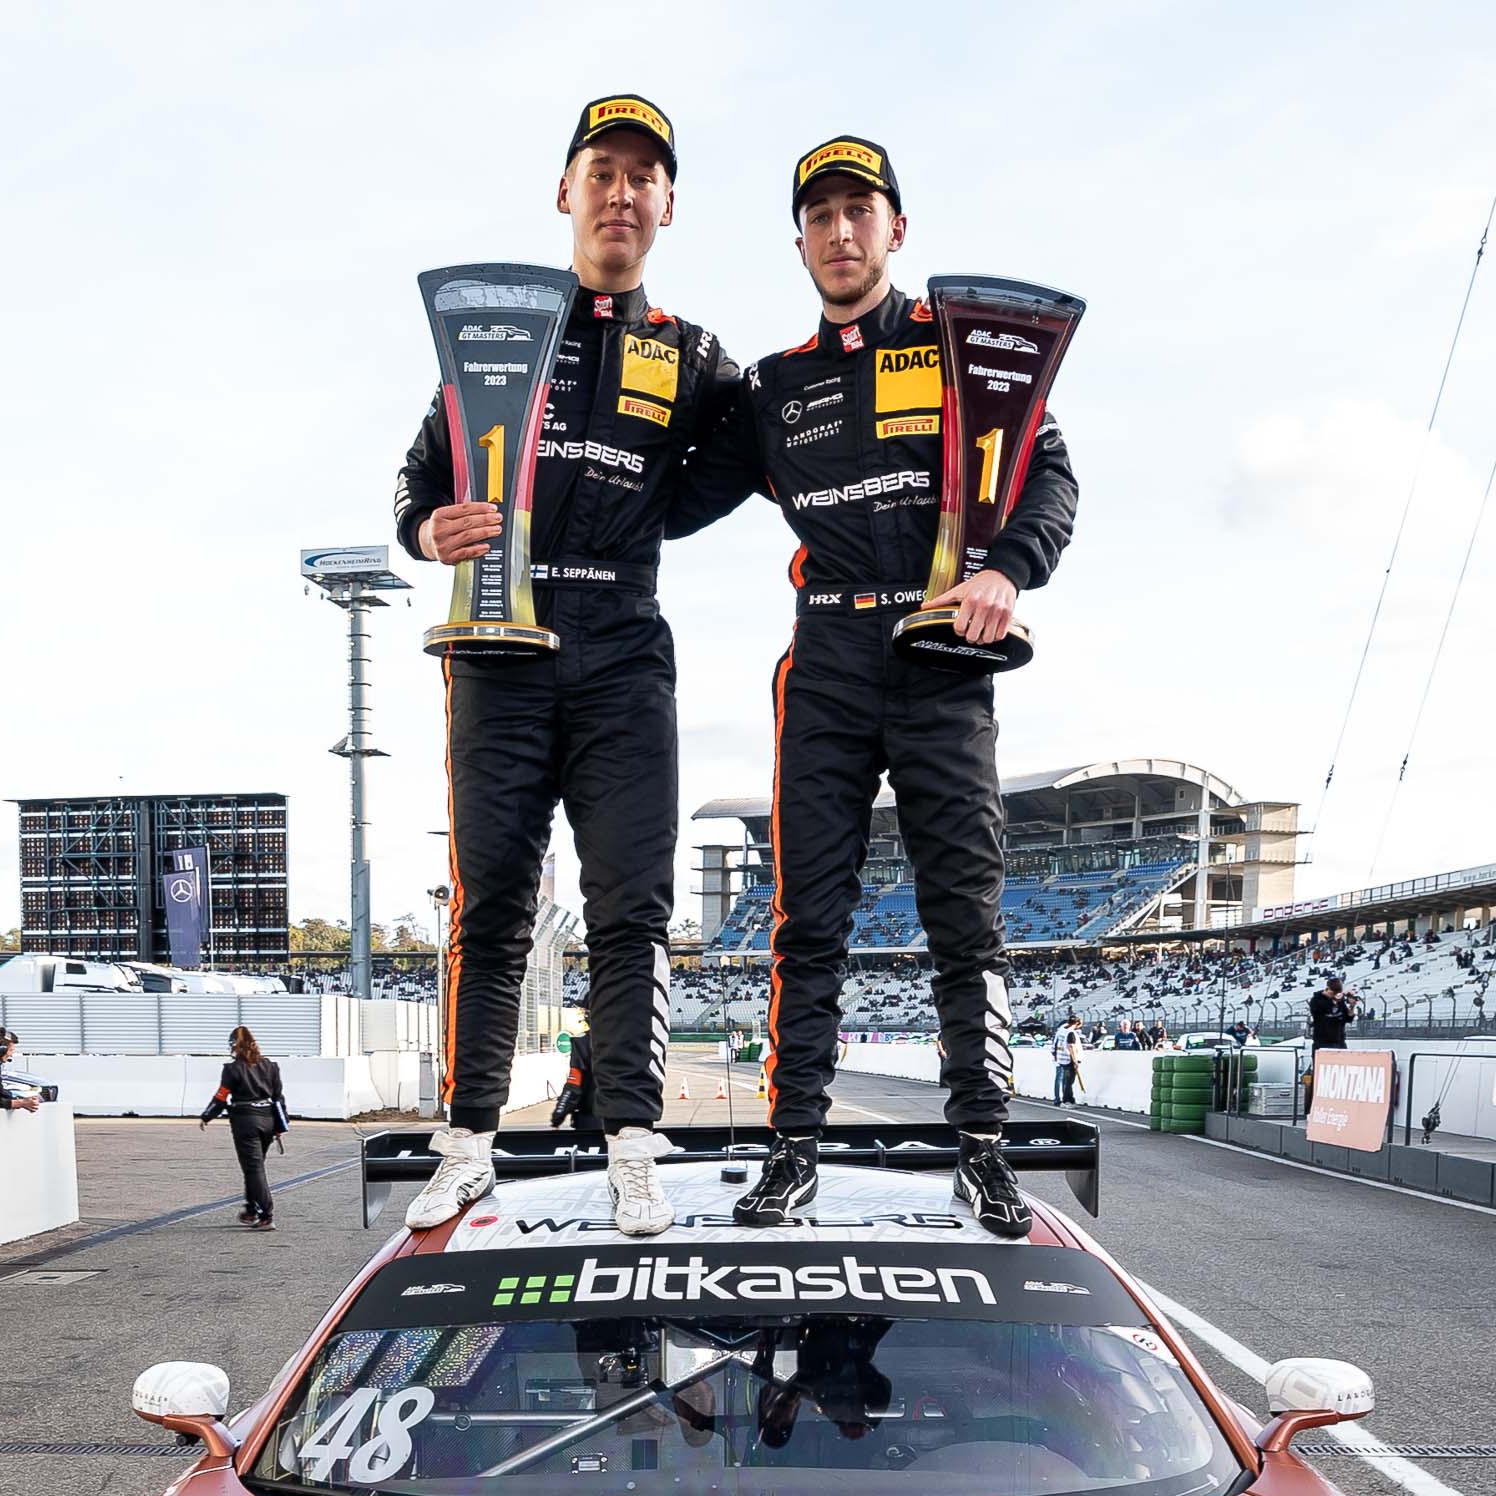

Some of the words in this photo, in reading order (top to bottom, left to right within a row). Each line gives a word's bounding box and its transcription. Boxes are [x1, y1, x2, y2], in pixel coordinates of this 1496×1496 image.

[598, 102, 664, 133] PIRELLI
[806, 147, 873, 172] PIRELLI
[627, 340, 677, 365] ADAC
[879, 349, 940, 373] ADAC
[464, 361, 528, 374] Fahrerwertung
[968, 363, 1032, 384] Fahrerwertung
[484, 375, 507, 386] 2023
[986, 380, 1010, 392] 2023
[883, 418, 934, 435] PIRELLI
[478, 424, 505, 503] 1
[536, 440, 645, 474] EINSBERG
[976, 428, 1004, 505] 1
[792, 471, 930, 511] WEINSBERG
[552, 567, 561, 577] E.
[880, 593, 892, 605] S.
[1317, 1064, 1385, 1104] MONTANA
[574, 1256, 997, 1305] bitkasten
[297, 1386, 435, 1484] 48
